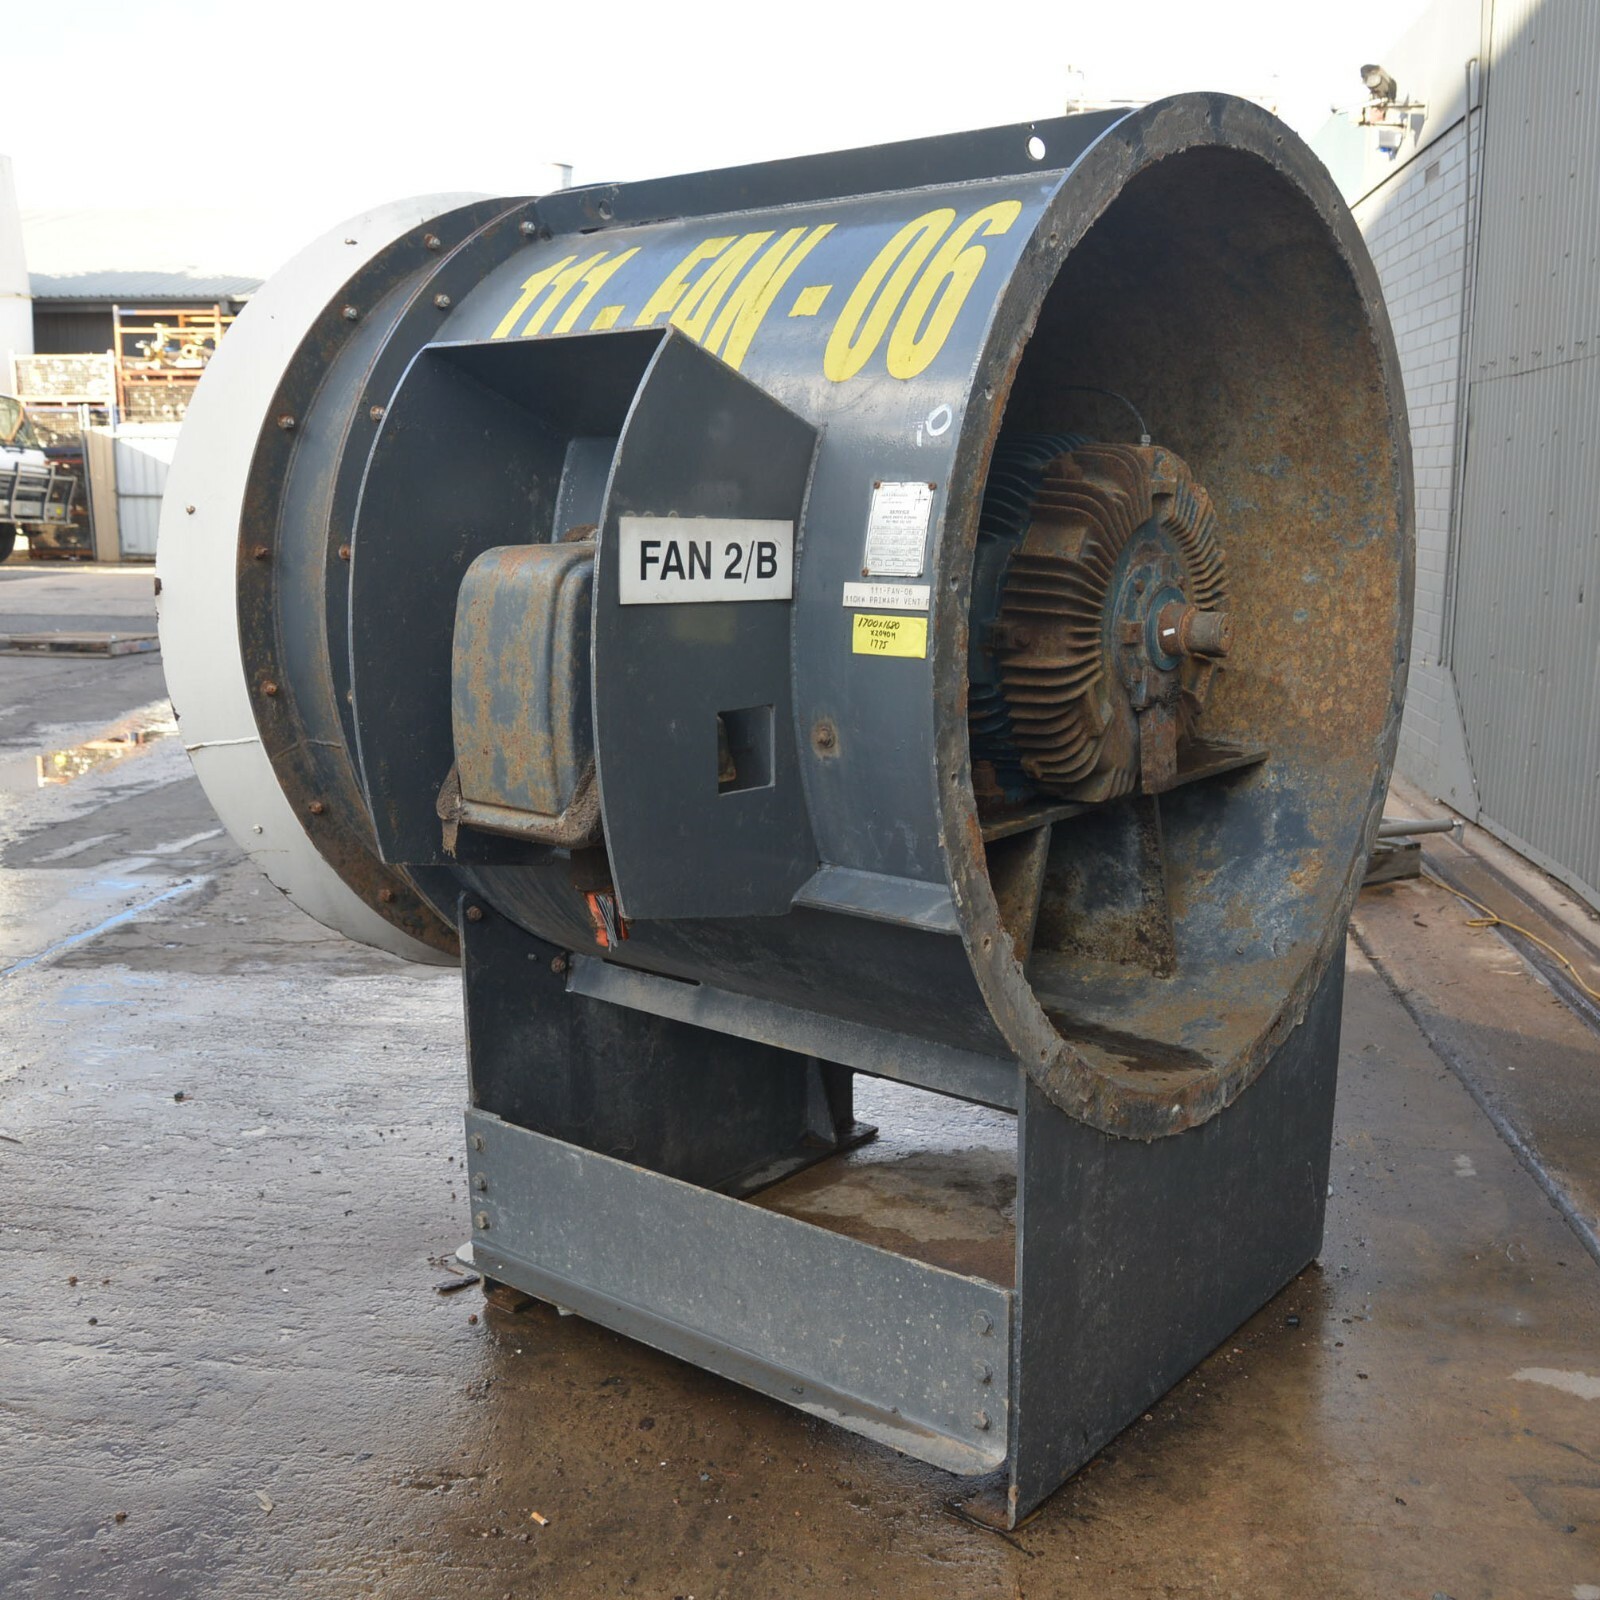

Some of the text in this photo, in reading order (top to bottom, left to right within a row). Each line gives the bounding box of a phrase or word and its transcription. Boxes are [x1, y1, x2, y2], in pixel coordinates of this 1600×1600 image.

[640, 540, 778, 584] FAN 2/B
[870, 586, 914, 596] 111-FAN-06
[869, 596, 900, 605] PRIMARY
[904, 597, 921, 606] VENT
